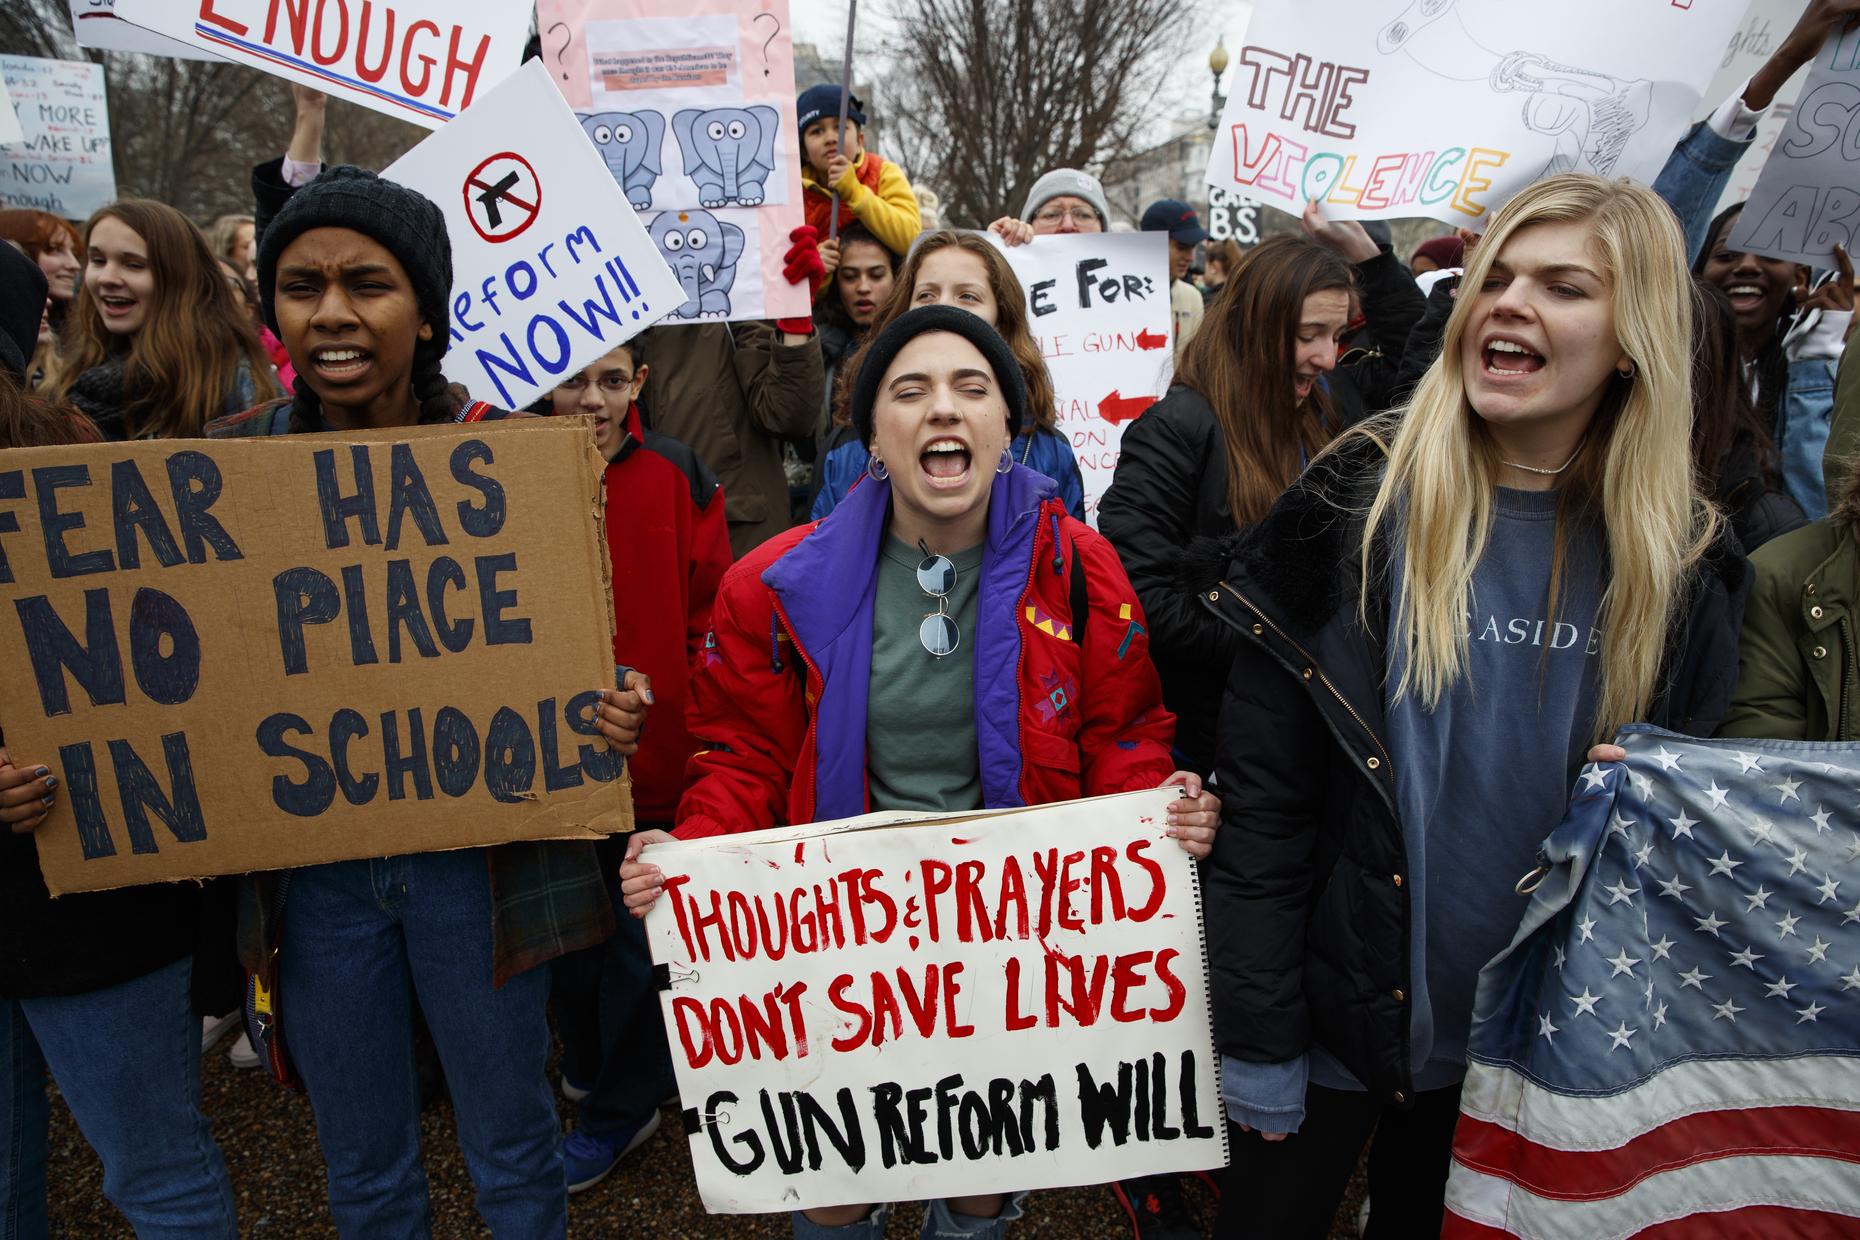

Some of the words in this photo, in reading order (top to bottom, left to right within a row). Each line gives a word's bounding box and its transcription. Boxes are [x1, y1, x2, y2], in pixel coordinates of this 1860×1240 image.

[24, 134, 72, 153] WAKE
[39, 103, 97, 127] MORE
[1240, 45, 1370, 139] THE
[12, 163, 73, 184] NOW
[1231, 123, 1511, 217] VIOLENCE
[1743, 185, 1860, 258] AB
[1210, 207, 1260, 244] B.S.
[448, 225, 602, 350] eform
[475, 256, 649, 410] NOW!!
[1083, 331, 1135, 353] GUN
[0, 449, 244, 583] FEAR
[313, 438, 507, 551] HAS
[14, 586, 201, 717] NO
[58, 731, 207, 860] IN
[256, 690, 624, 817] SCHOOLS
[660, 868, 898, 963] THOUGHTS
[919, 839, 1167, 944] PRAYERS
[672, 981, 808, 1069] DON'T
[828, 960, 975, 1052] SAVE
[1005, 947, 1187, 1032] LIVES
[707, 1087, 867, 1177] GUN
[867, 1072, 1060, 1169] REFORM
[1075, 1049, 1214, 1151] WILL
